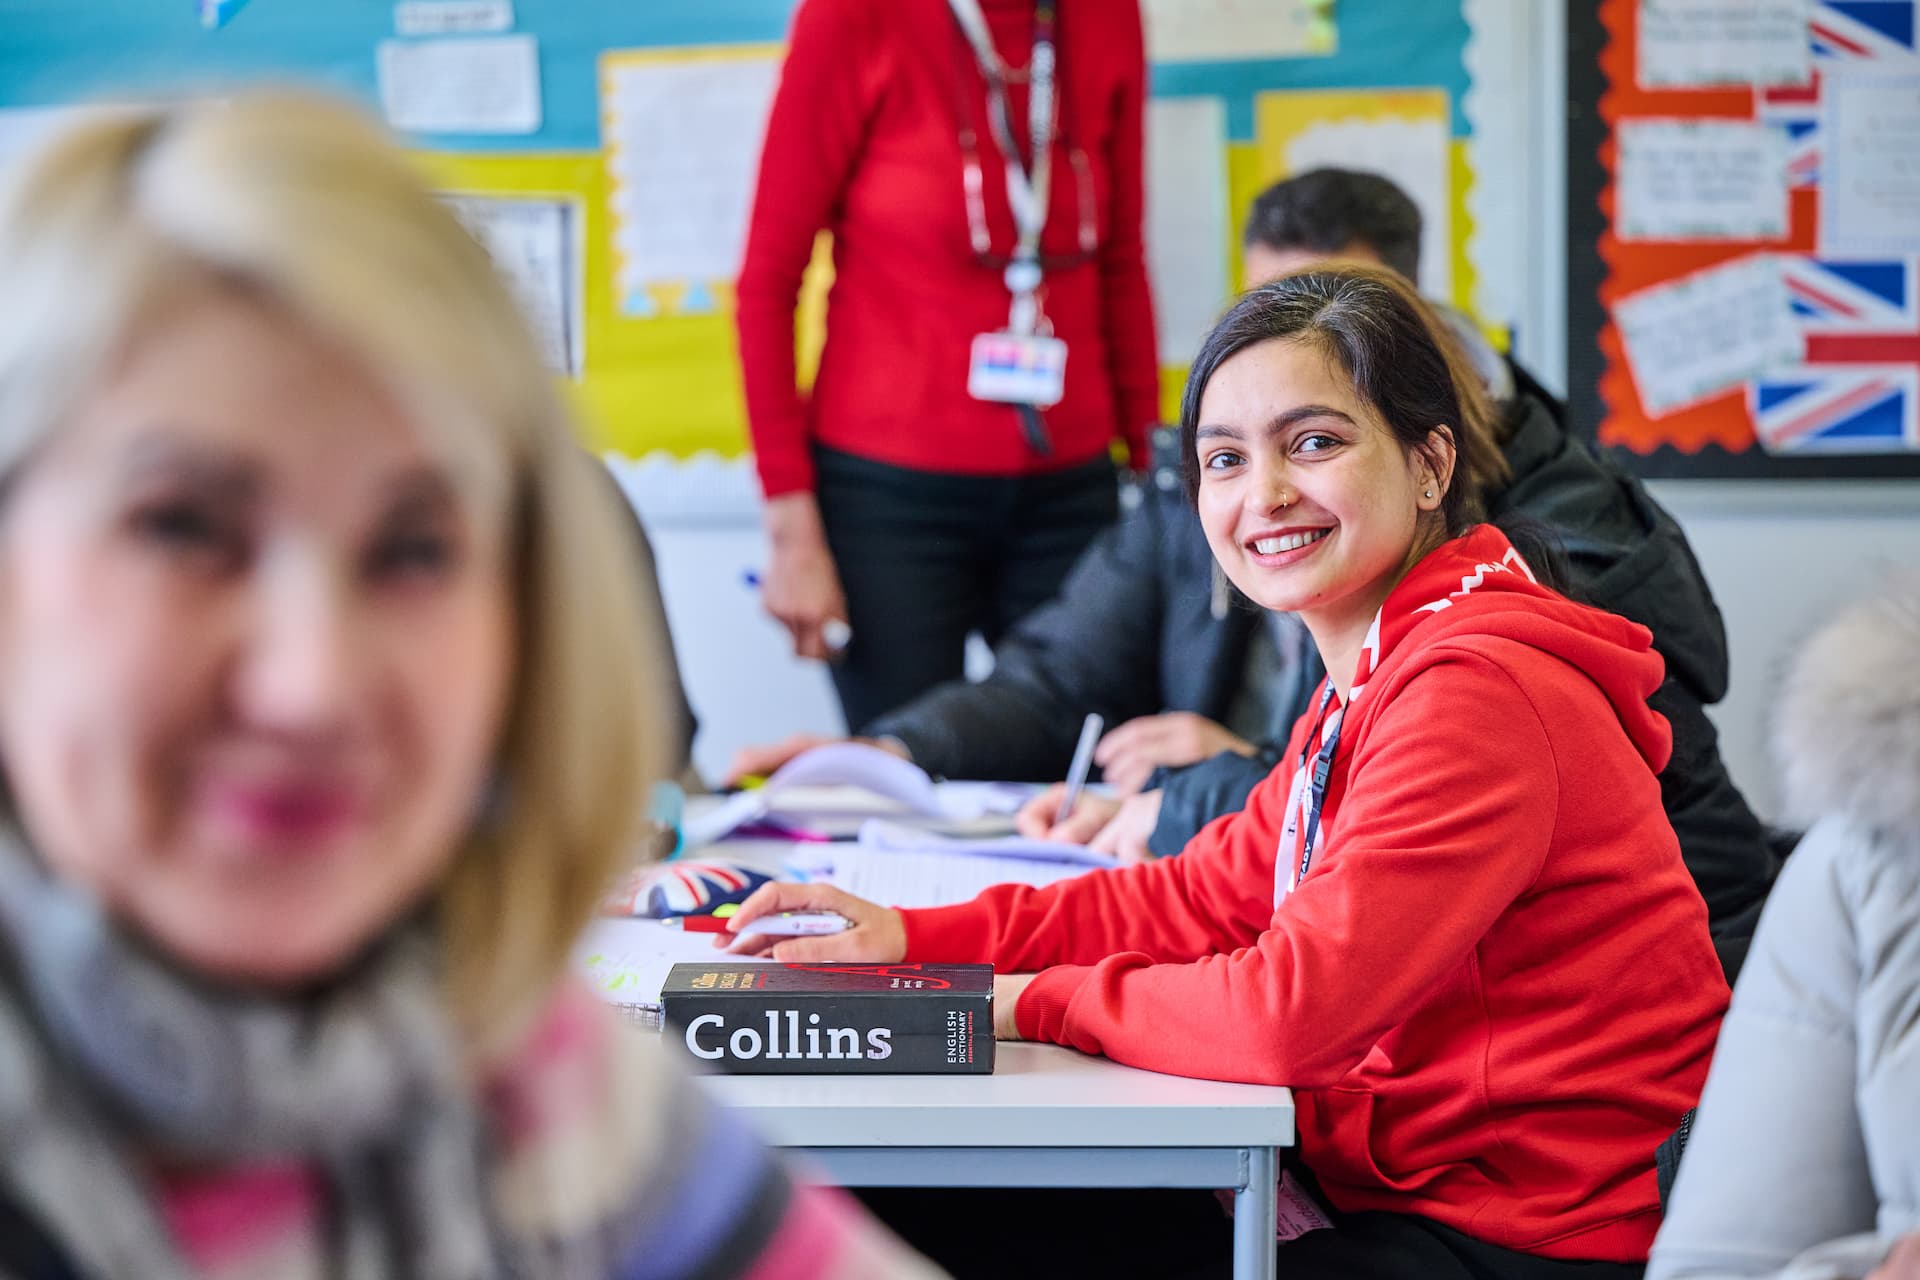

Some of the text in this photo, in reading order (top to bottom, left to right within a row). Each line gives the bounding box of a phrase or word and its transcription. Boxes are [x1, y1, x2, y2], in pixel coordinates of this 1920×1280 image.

[684, 1010, 893, 1060] Collins
[947, 1011, 957, 1063] ENGLISH
[958, 1011, 966, 1063] DICTIONARY
